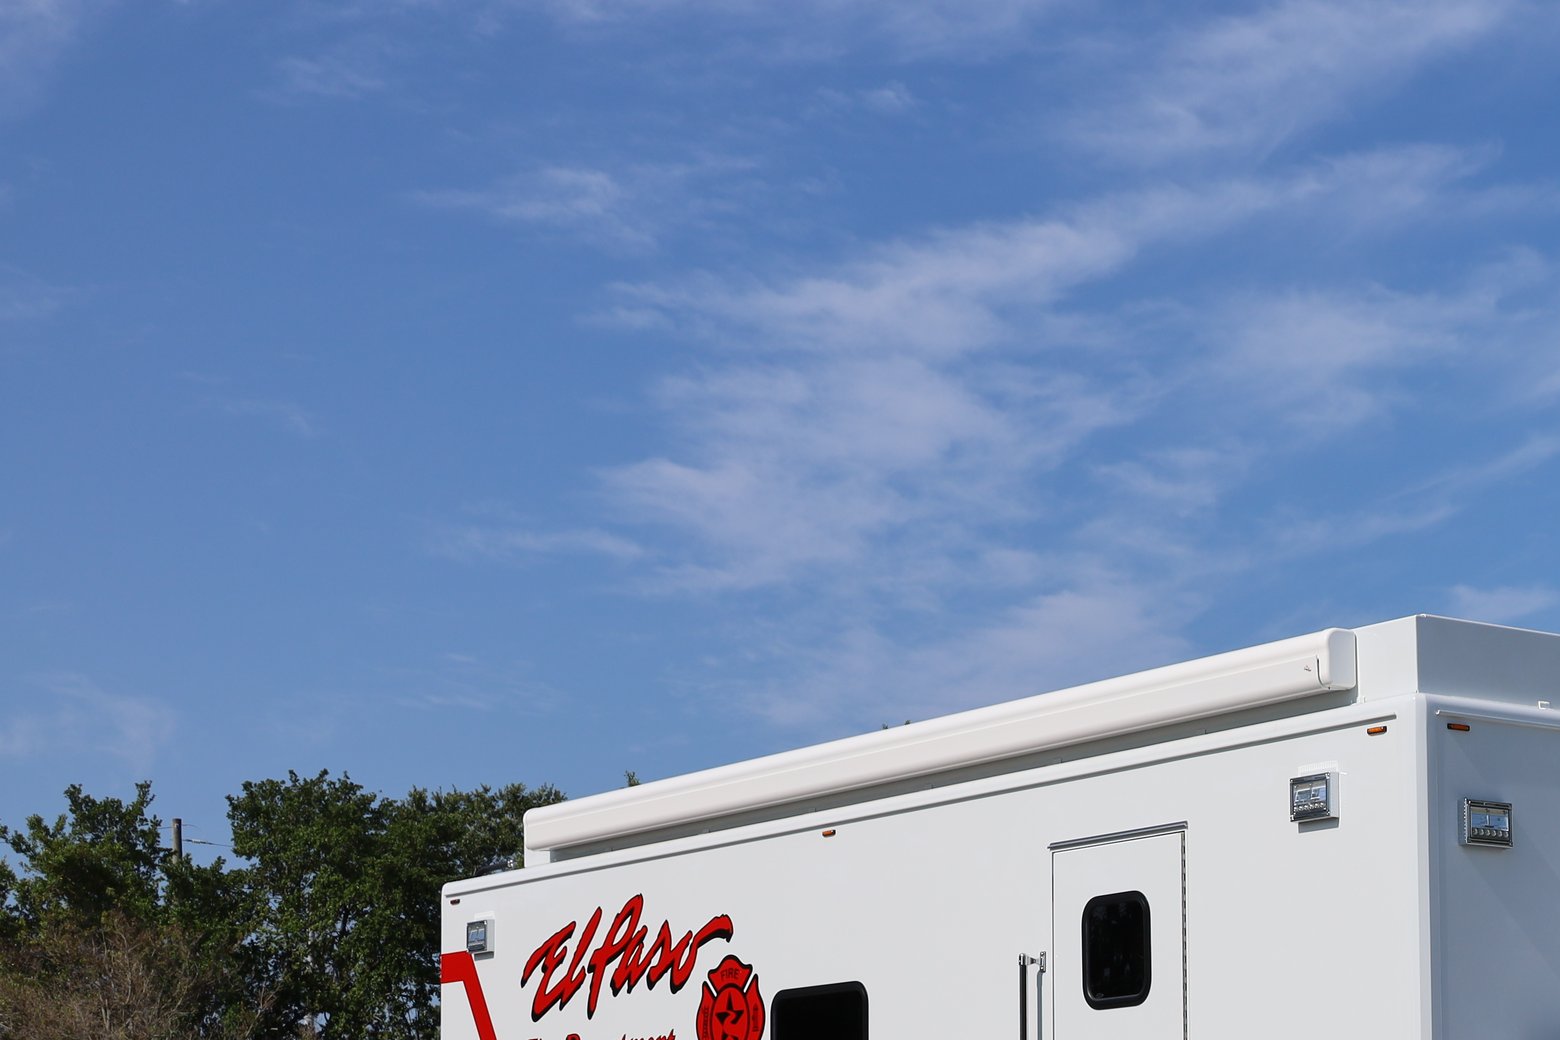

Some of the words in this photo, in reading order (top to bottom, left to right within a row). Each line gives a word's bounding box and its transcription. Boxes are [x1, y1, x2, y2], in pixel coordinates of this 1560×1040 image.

[521, 906, 602, 1022] El
[587, 893, 733, 1020] Paso
[720, 968, 739, 980] FIRE
